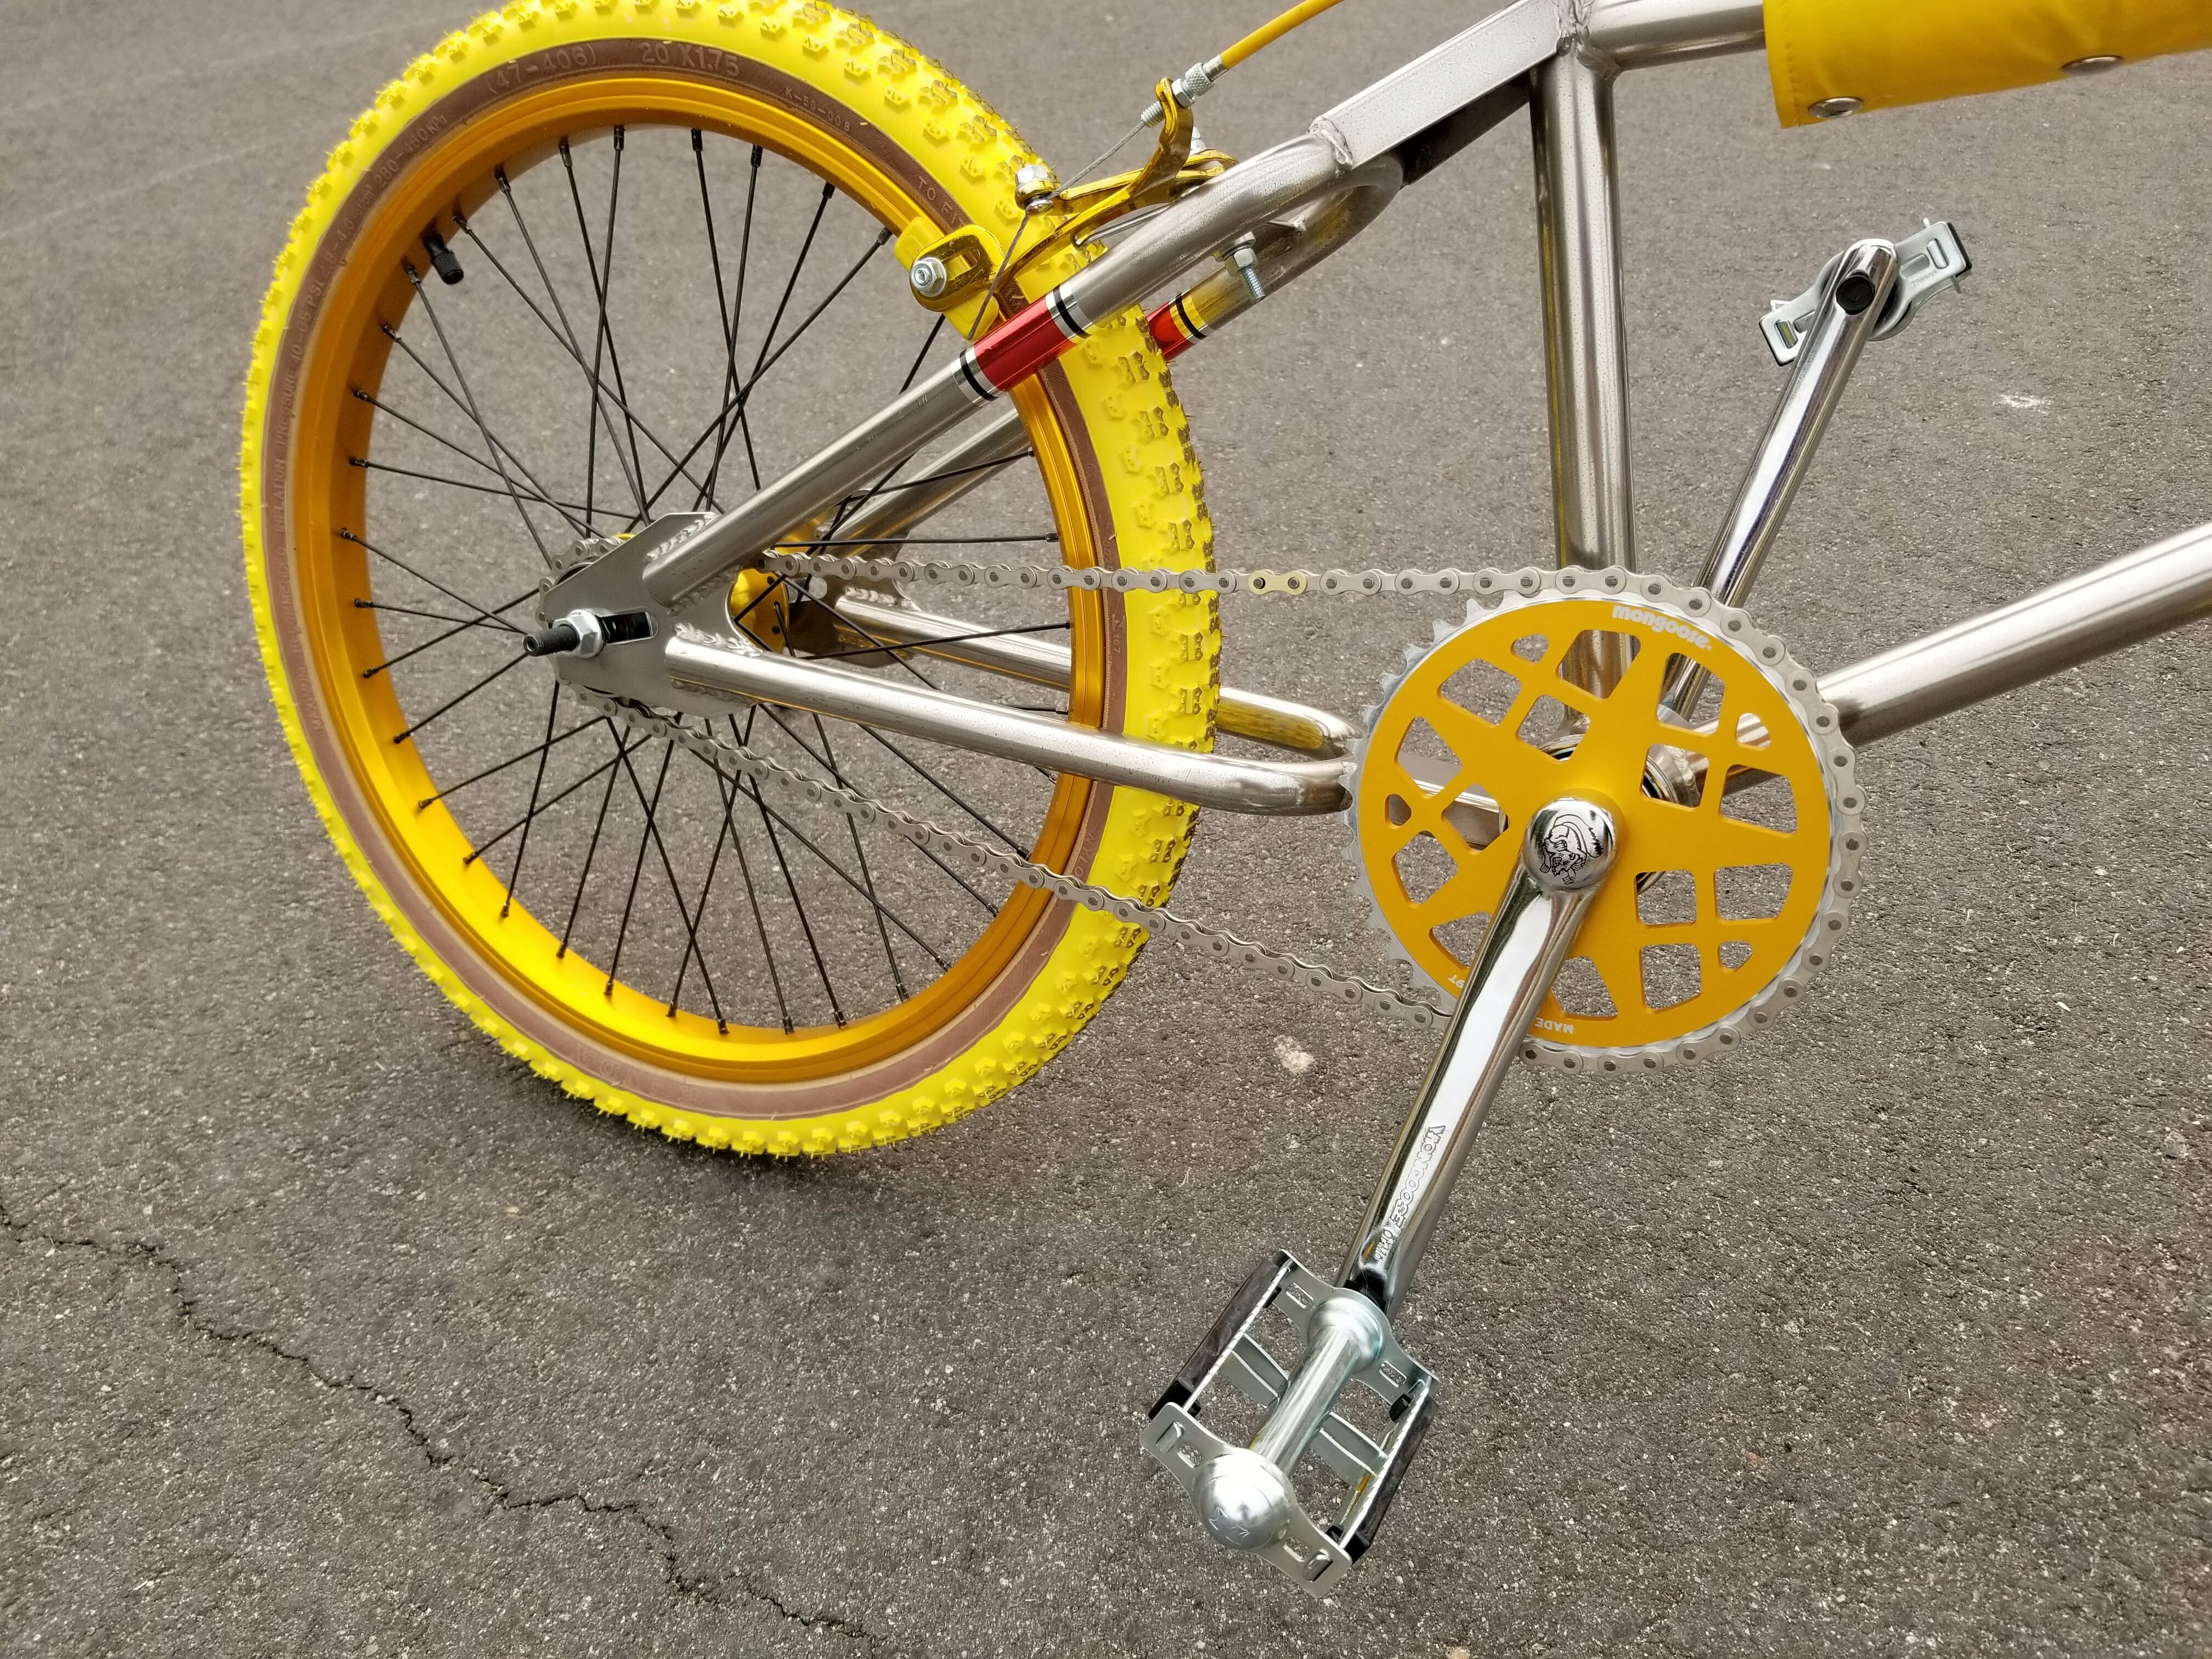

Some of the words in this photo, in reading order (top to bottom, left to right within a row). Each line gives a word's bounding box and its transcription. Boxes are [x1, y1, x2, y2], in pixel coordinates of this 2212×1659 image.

[486, 43, 596, 94] (47-406)
[639, 42, 670, 65] 20
[678, 43, 740, 77] X1.75
[785, 87, 851, 132] K-50-008
[919, 176, 935, 200] TO
[941, 202, 964, 228] FIT
[306, 279, 323, 307] PSI
[276, 375, 297, 445] PRESSURE
[274, 459, 286, 535] INFLATION
[1612, 605, 1709, 649] mongoose
[1075, 832, 1096, 877] NYLO
[1535, 1018, 1574, 1034] MADE
